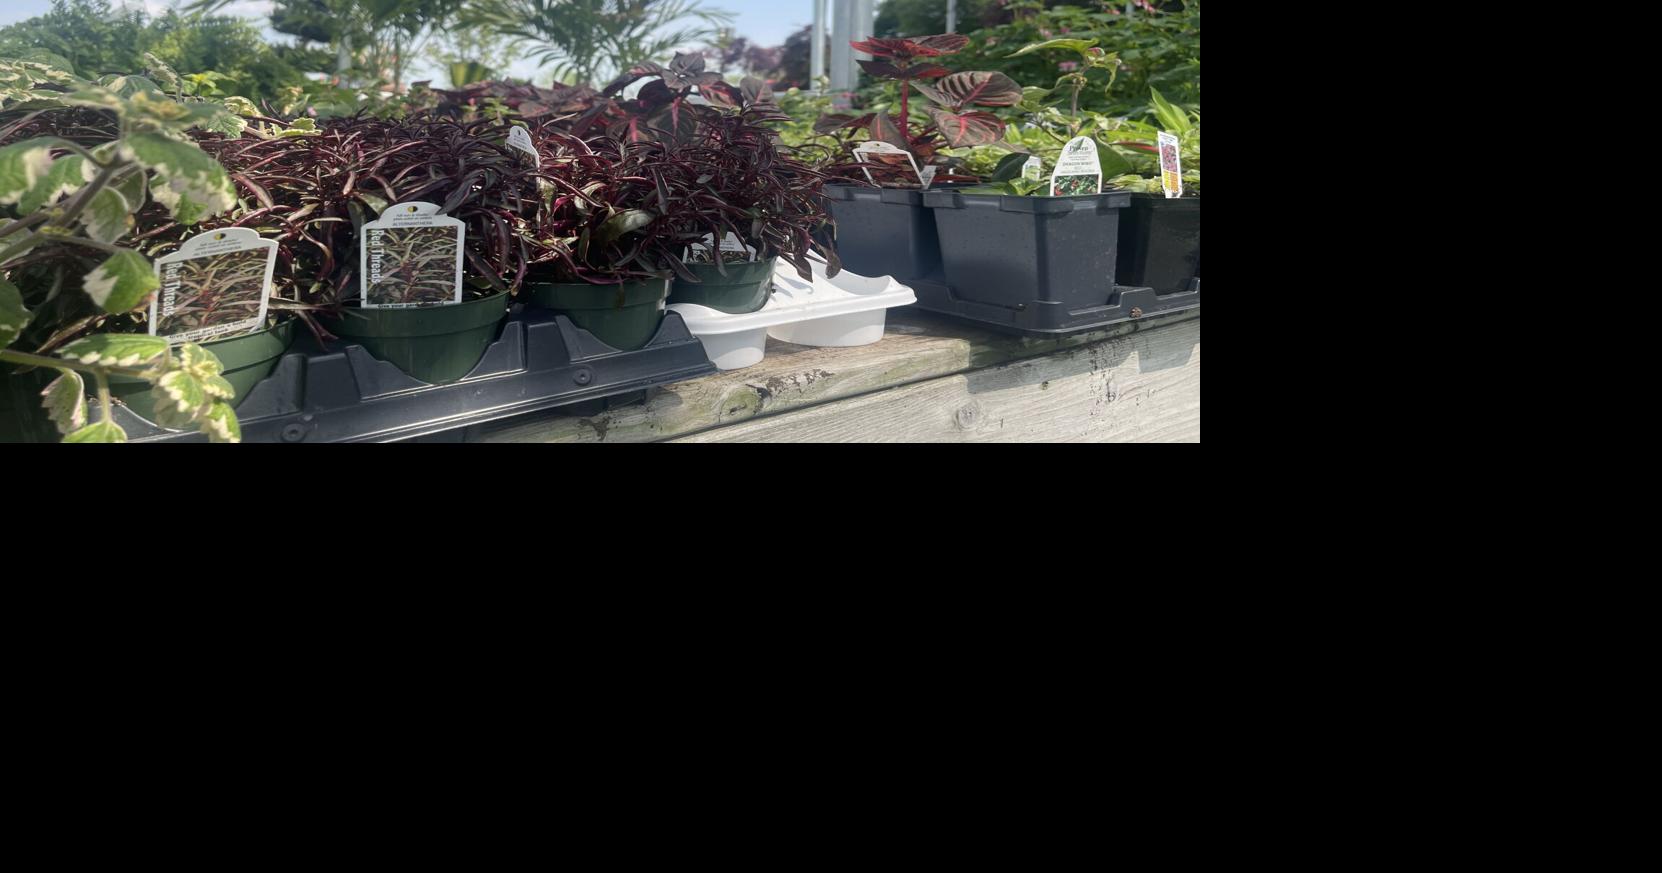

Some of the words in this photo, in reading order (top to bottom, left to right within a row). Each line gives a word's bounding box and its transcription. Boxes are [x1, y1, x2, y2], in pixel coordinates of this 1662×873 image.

[371, 230, 385, 246] Red
[166, 261, 184, 279] Red
[371, 248, 385, 284] Threads
[163, 280, 180, 316] Threads
